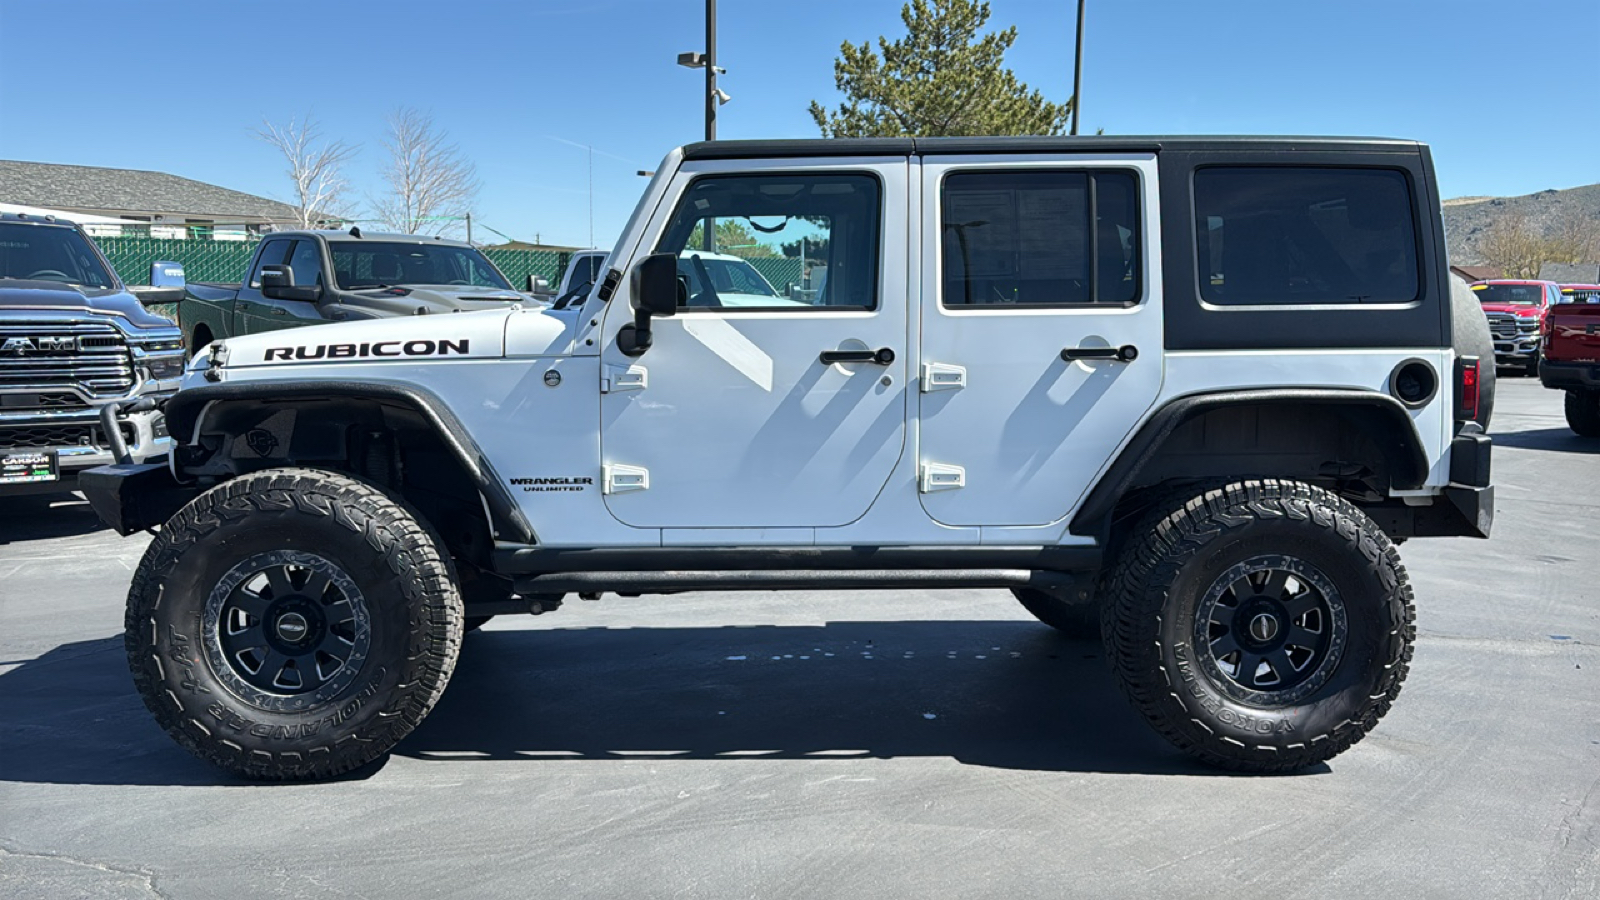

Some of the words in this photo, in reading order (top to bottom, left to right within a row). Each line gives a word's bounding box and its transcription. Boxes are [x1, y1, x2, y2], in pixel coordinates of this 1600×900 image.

[0, 336, 76, 351] AM
[264, 339, 470, 361] RUBICON
[509, 477, 594, 485] WRANGLER
[1174, 641, 1296, 735] YOKOHAMA
